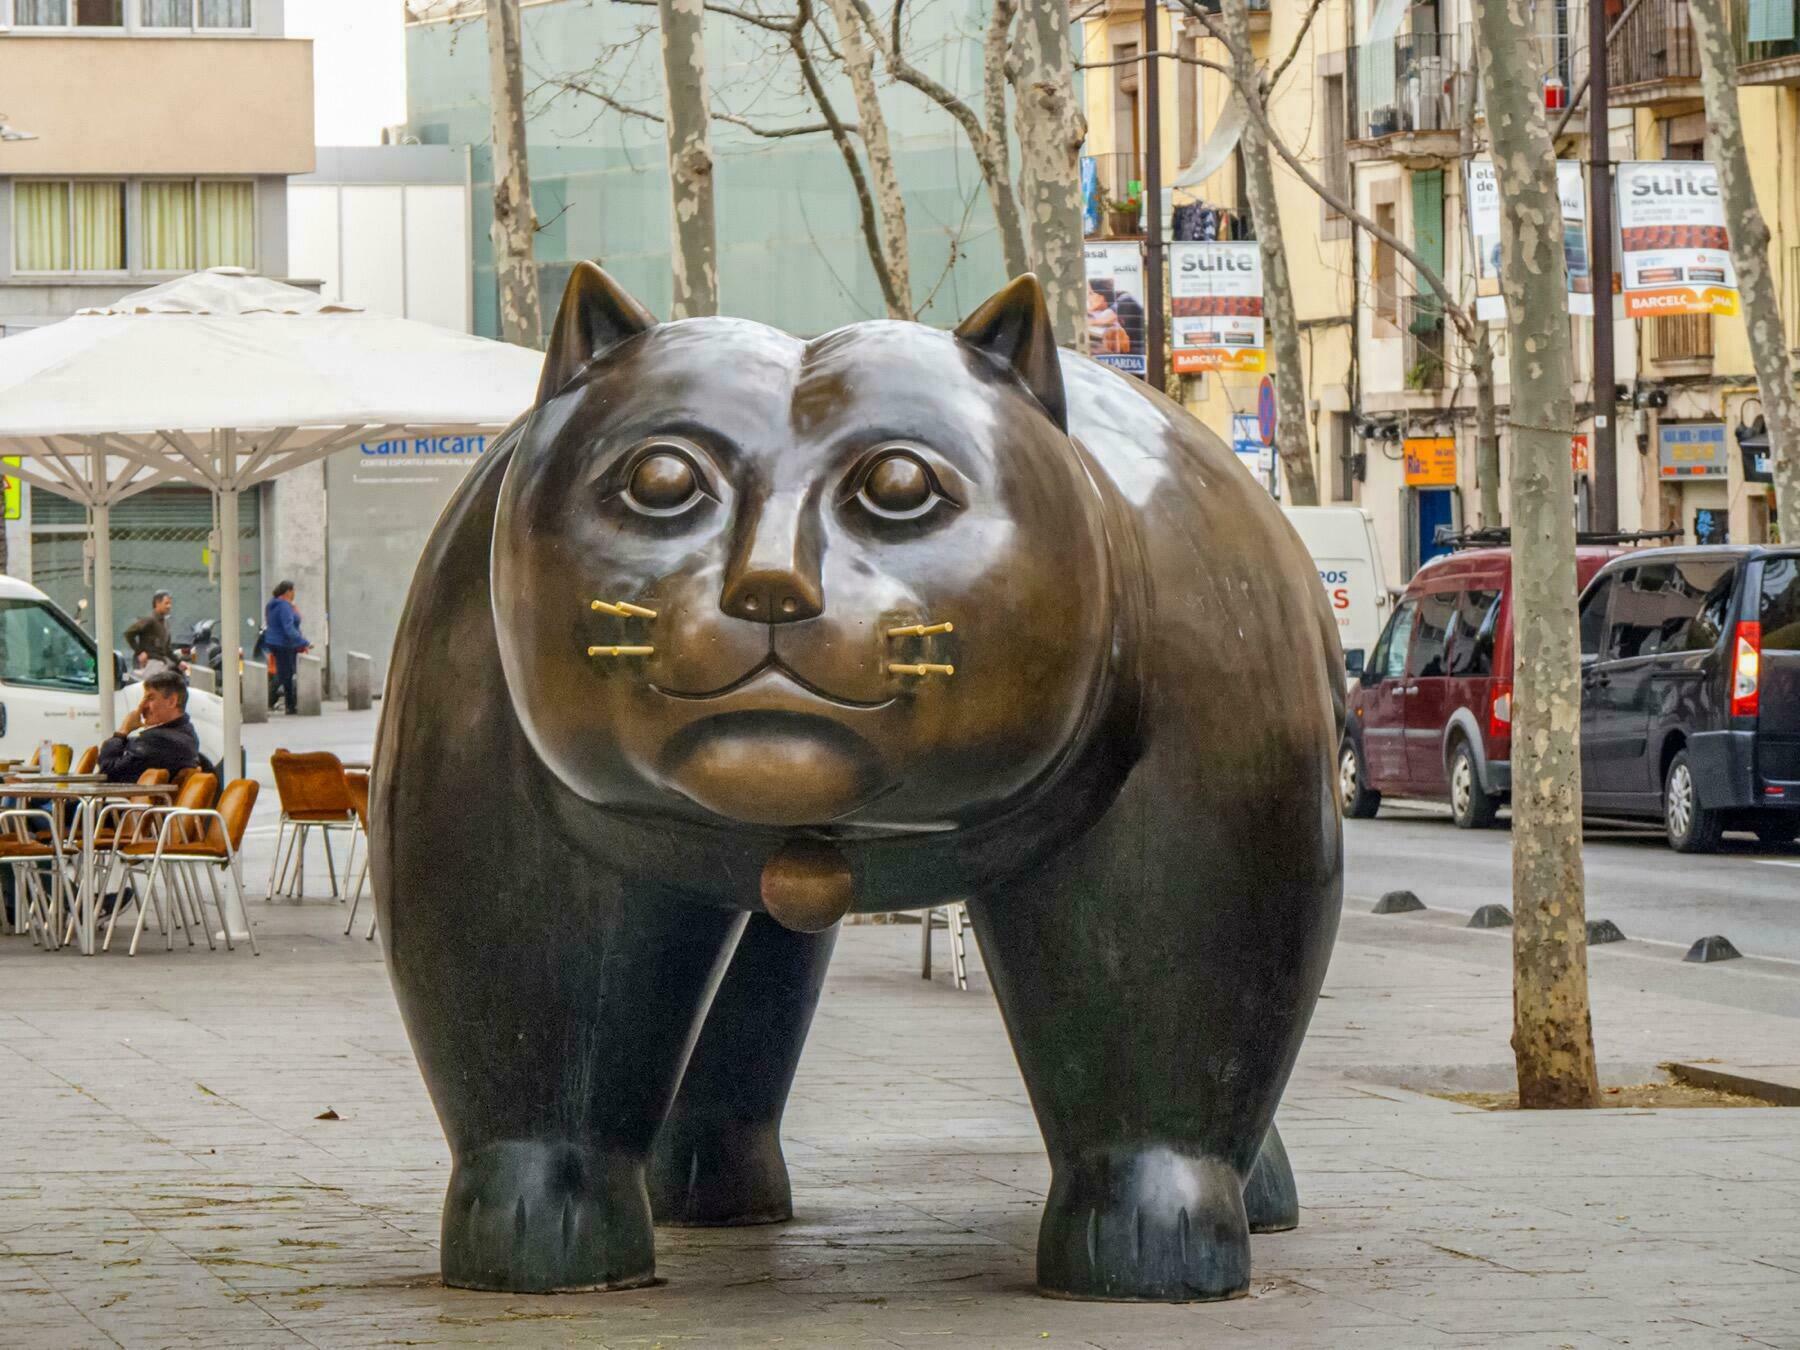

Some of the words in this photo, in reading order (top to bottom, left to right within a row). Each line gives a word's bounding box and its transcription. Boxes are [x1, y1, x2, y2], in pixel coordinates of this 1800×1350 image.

[1477, 181, 1493, 191] de
[1631, 167, 1720, 196] suite
[1181, 247, 1253, 272] suite
[415, 434, 486, 454] Ricart
